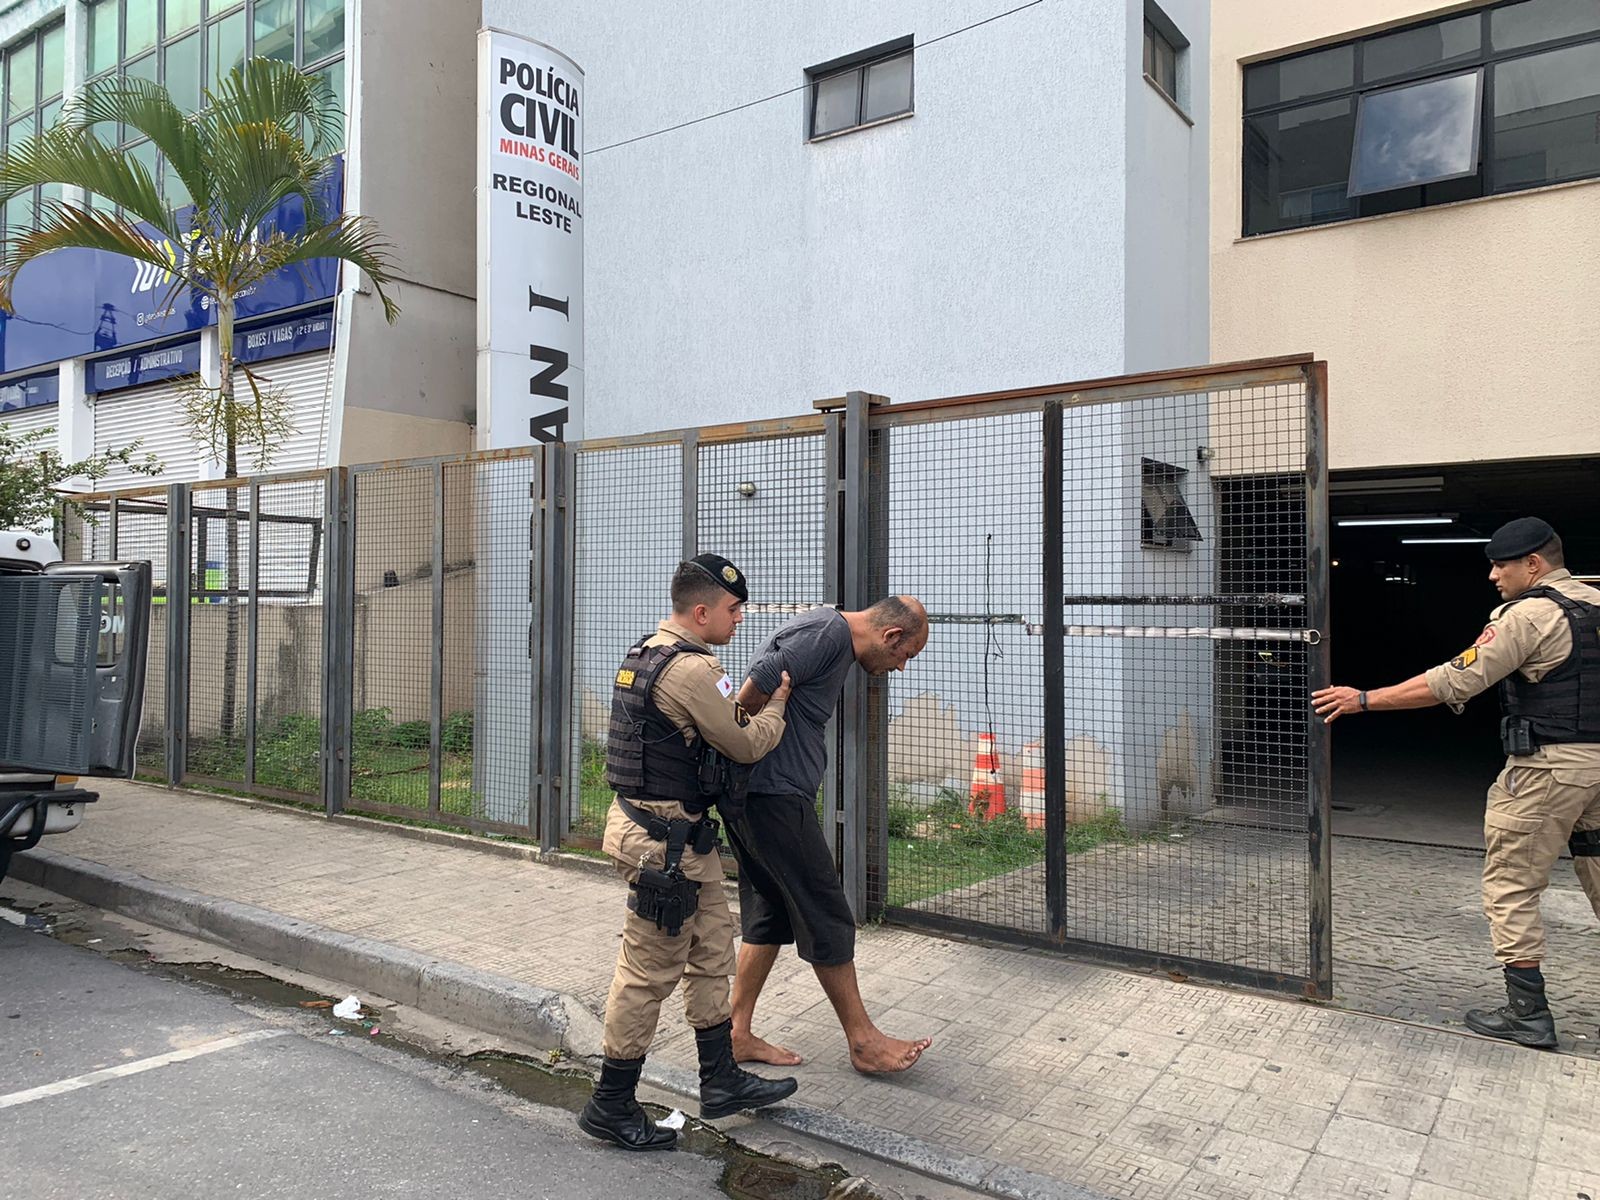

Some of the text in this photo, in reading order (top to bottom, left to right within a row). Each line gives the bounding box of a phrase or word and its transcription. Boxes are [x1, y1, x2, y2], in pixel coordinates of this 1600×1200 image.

[499, 57, 579, 117] POLÍCIA
[500, 93, 579, 161] CIVIL
[500, 138, 579, 181] MINAS GERAIS
[493, 173, 582, 219] REGIONAL
[516, 201, 571, 234] LESTE
[247, 332, 267, 349] BOXES
[272, 326, 293, 343] VAGAS
[105, 358, 132, 379] RECEPÇÃO
[140, 349, 183, 370] ADMINISTRATIVO
